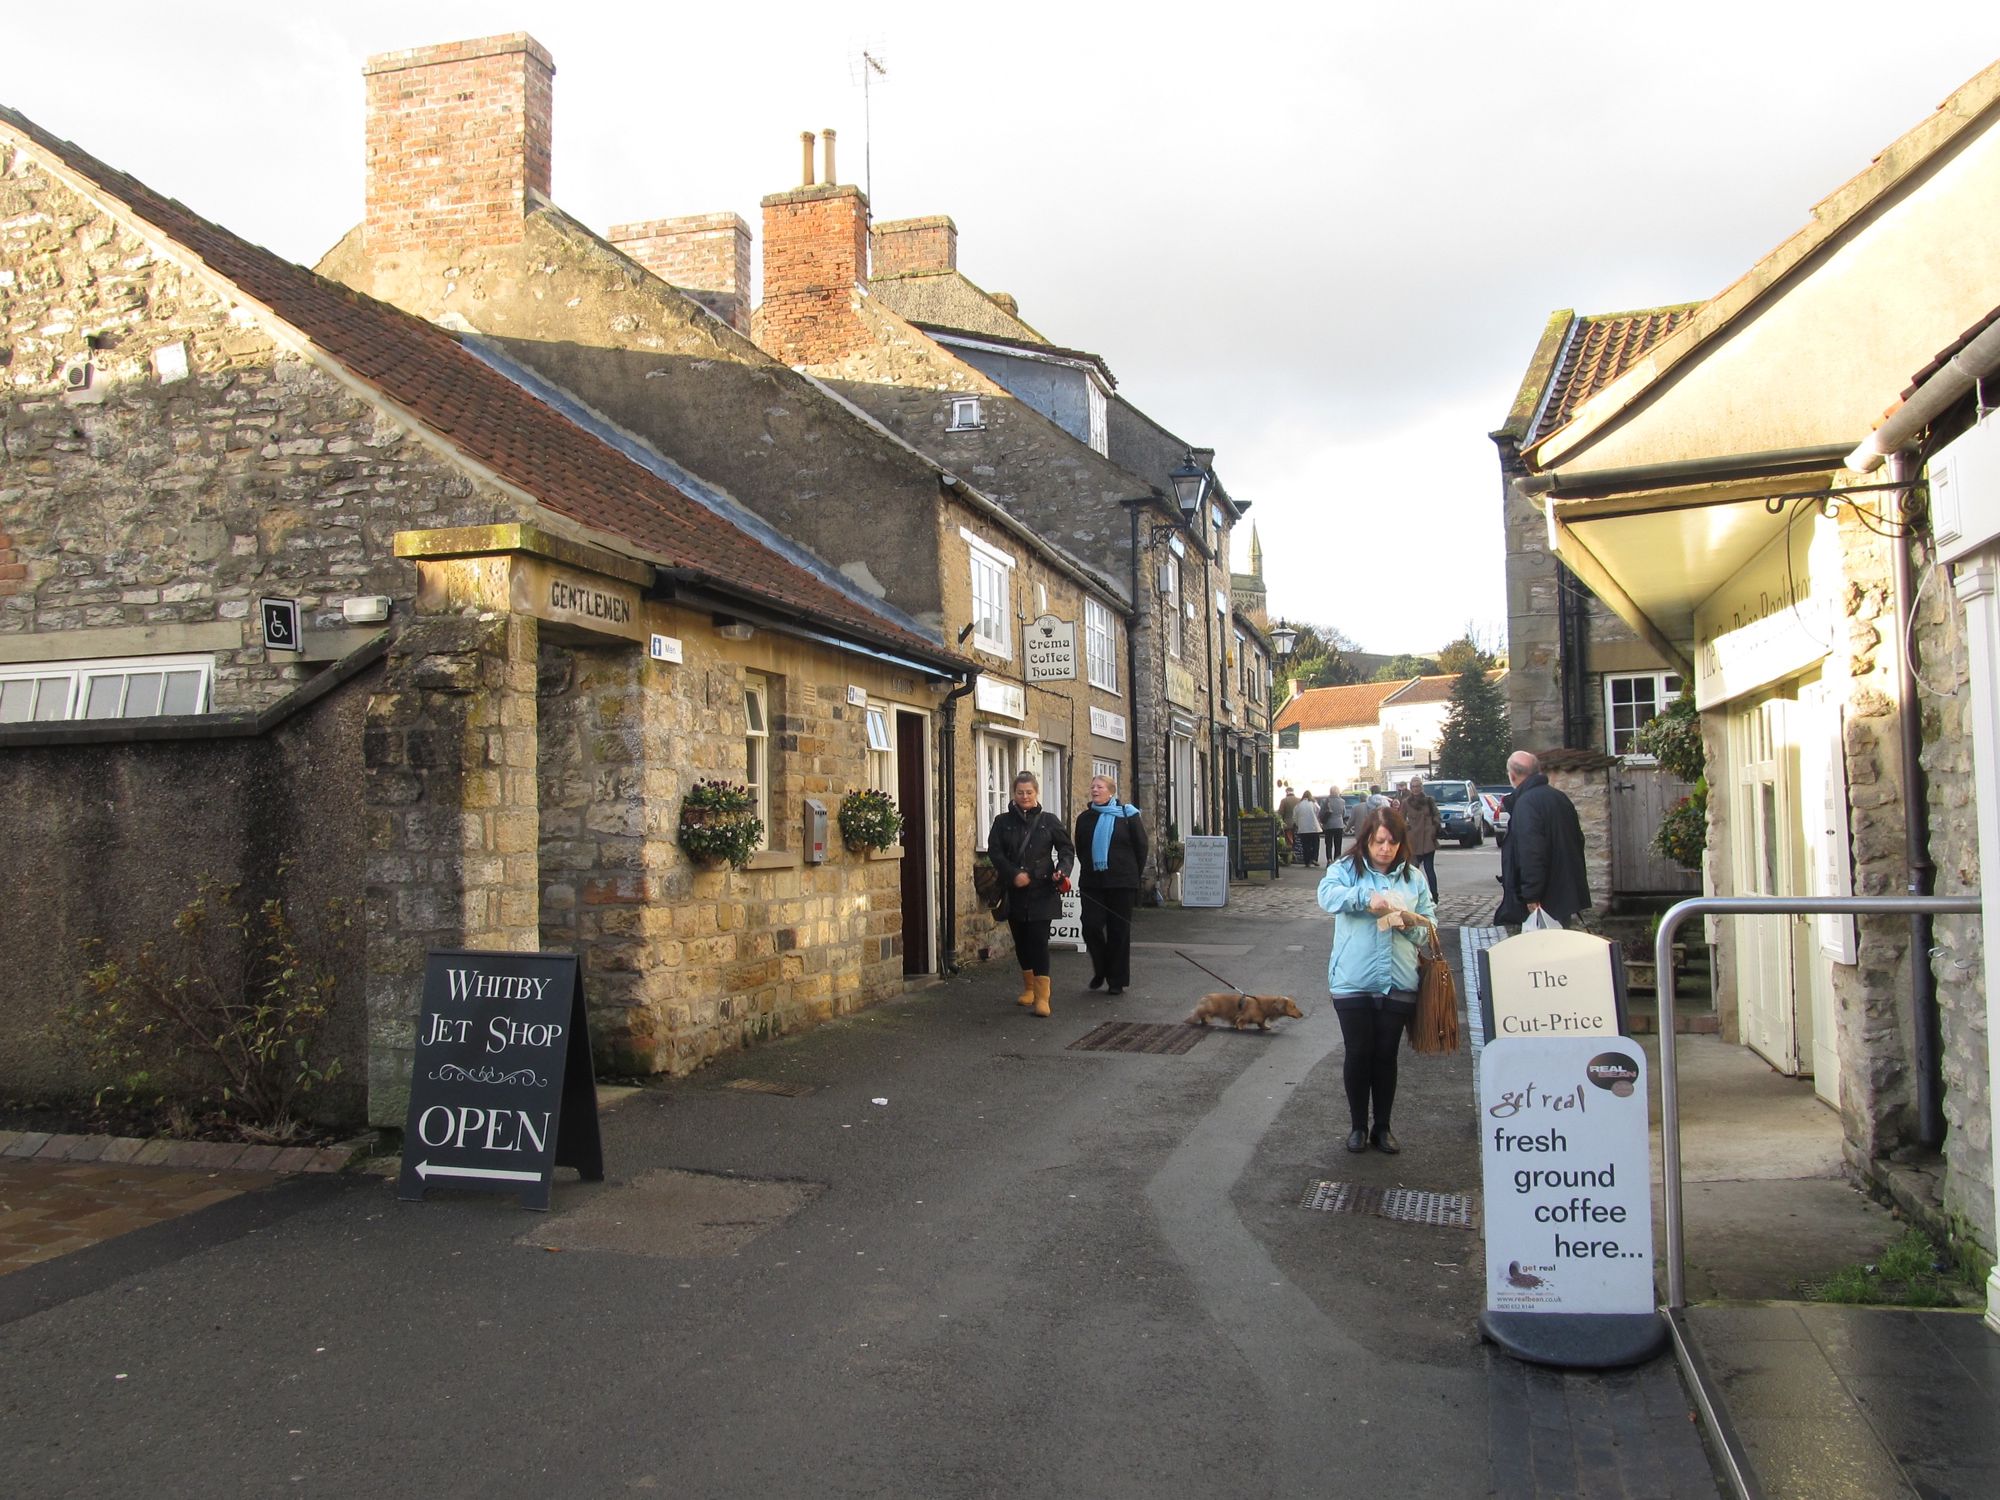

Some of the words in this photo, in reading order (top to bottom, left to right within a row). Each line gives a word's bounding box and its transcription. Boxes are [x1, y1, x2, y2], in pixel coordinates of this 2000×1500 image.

[551, 580, 630, 624] GENTLEMEN
[1028, 638, 1070, 650] Crema
[1030, 652, 1071, 664] Coffee
[1031, 665, 1071, 679] House
[1049, 925, 1080, 939] pen
[446, 968, 552, 1002] WHITBY
[1528, 970, 1568, 989] The
[421, 1012, 473, 1047] JET
[485, 1016, 563, 1054] SHOP
[1502, 1011, 1604, 1034] Cut-Price
[1590, 1065, 1628, 1073] REAL
[1489, 1081, 1537, 1119] get
[1542, 1084, 1586, 1113] real
[418, 1104, 552, 1153] OPEN
[1494, 1127, 1568, 1152] fresh
[1514, 1163, 1615, 1194] ground
[1534, 1197, 1627, 1223] coffee
[1554, 1233, 1644, 1259] here...
[1522, 1264, 1537, 1273] get
[1539, 1263, 1556, 1272] real
[1496, 1295, 1562, 1303] www.realbean.co.uk
